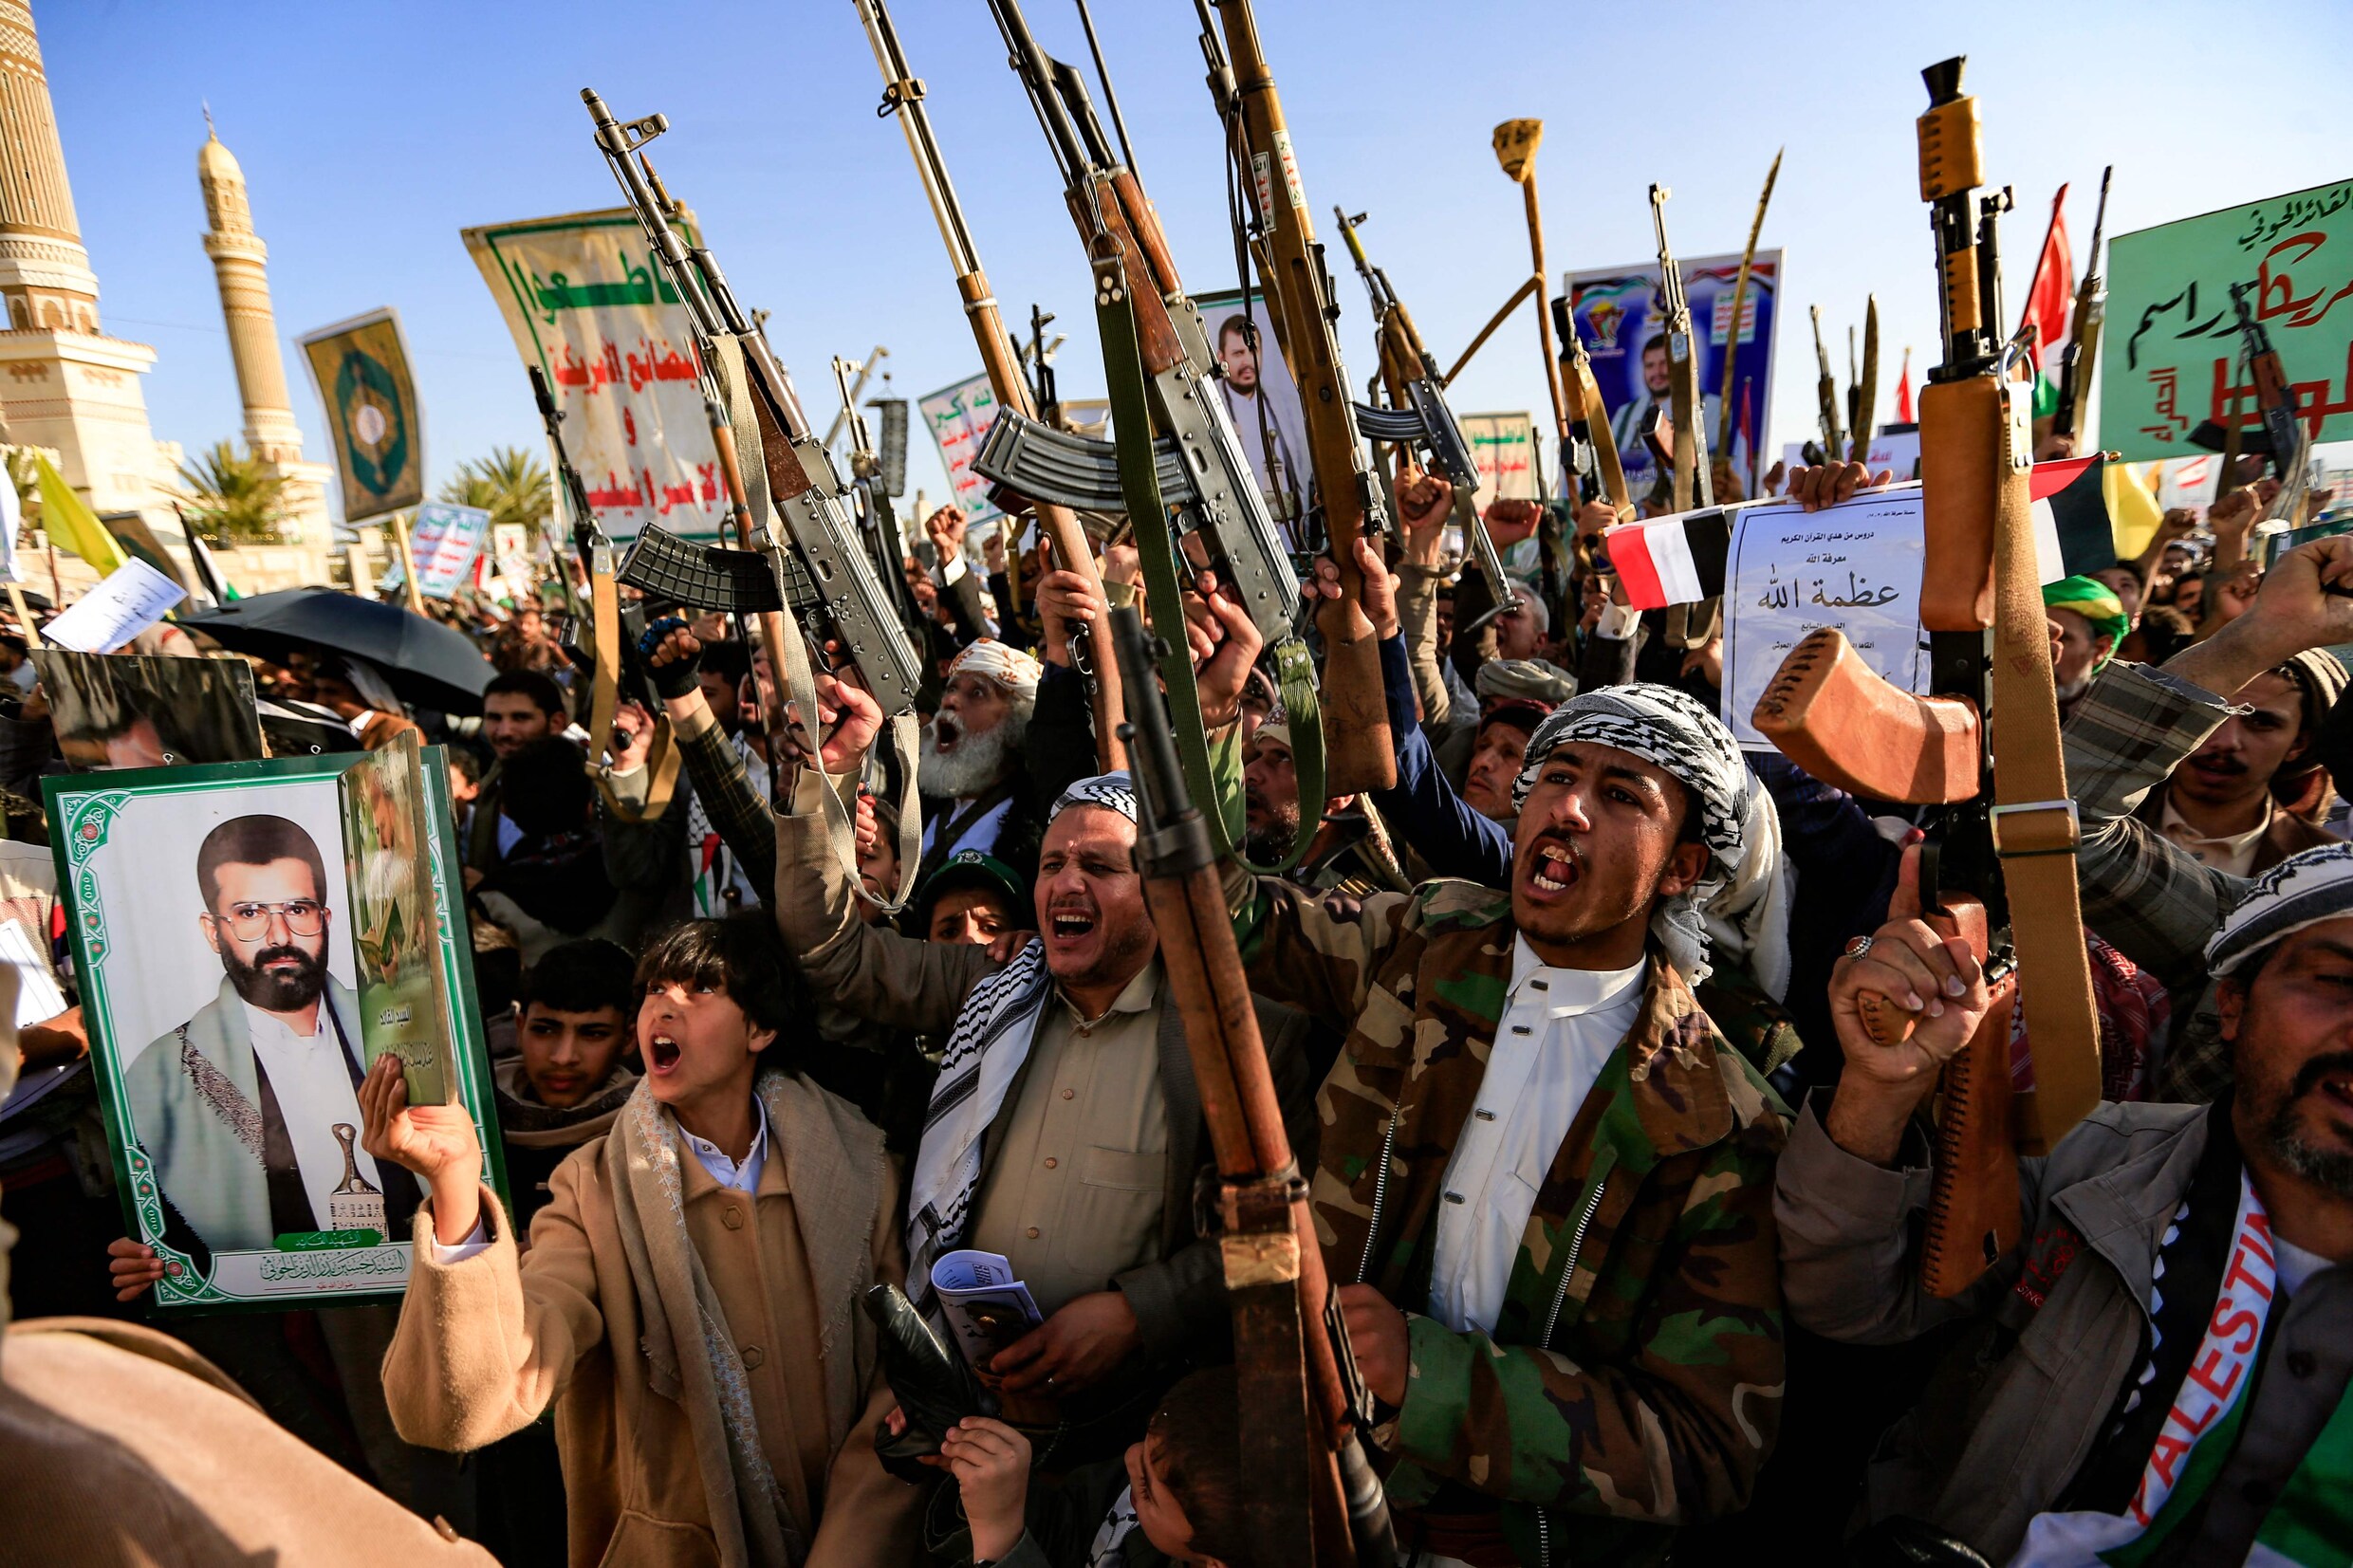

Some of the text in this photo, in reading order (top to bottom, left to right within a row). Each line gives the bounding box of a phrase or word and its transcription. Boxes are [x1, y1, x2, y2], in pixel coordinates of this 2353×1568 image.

[2292, 185, 2353, 230] لقائد
[512, 249, 692, 325] اطعوا
[626, 336, 704, 393] لبضائع
[622, 405, 637, 447] و
[587, 461, 730, 516] الإسرائيلي
[1781, 533, 1804, 544] الكريم
[1843, 532, 1853, 541] من
[1854, 531, 1874, 541] دروس
[1806, 553, 1846, 564] معرفة الله
[1757, 563, 1899, 610] عظمة الله
[2017, 1285, 2044, 1307] SINC
[2128, 1187, 2277, 1526] PALESTIN
